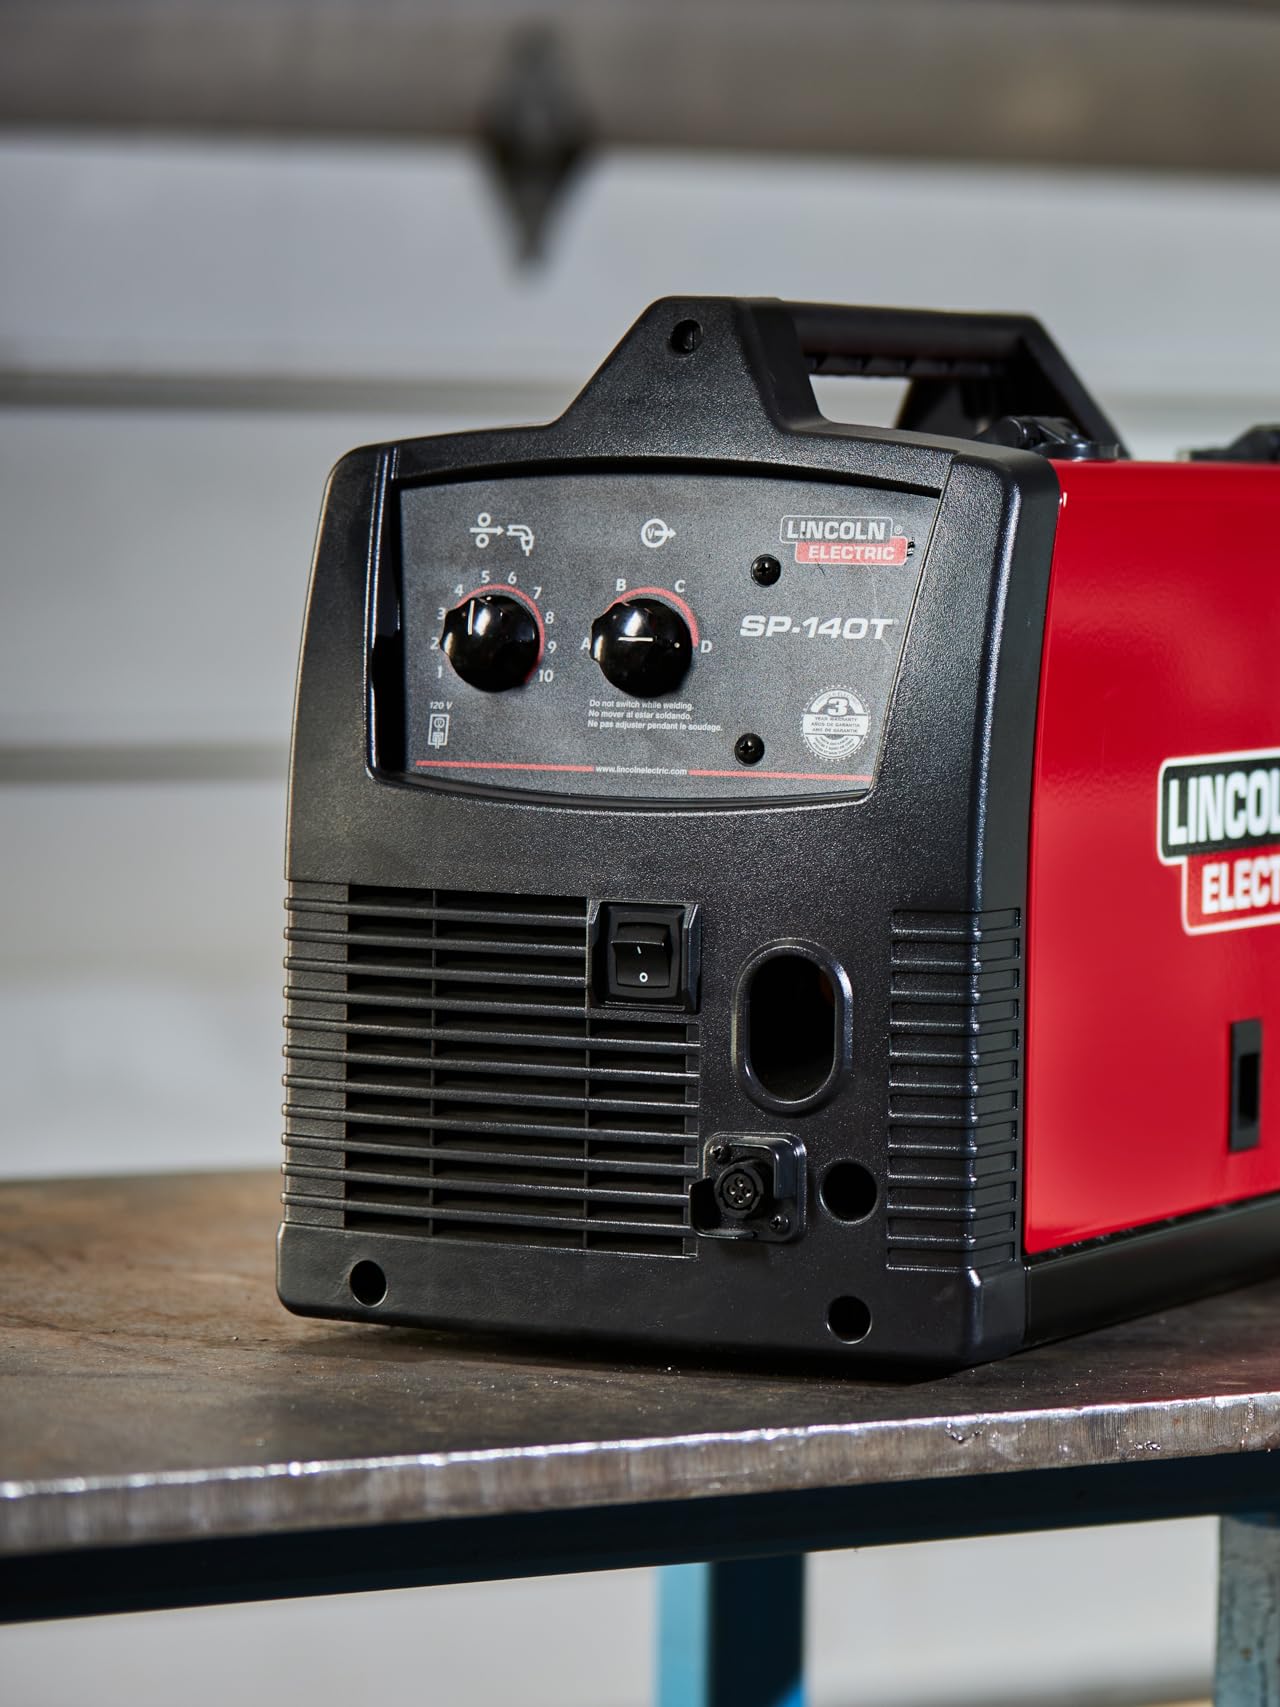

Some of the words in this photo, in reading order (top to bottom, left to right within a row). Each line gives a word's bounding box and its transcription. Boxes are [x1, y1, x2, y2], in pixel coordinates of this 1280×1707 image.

[787, 520, 885, 540] LINCOLN
[807, 545, 895, 561] ELECTRIC
[480, 570, 490, 583] 5
[507, 571, 518, 585] 6
[454, 584, 464, 597] 4
[616, 578, 627, 592] B
[674, 579, 686, 593] C
[533, 587, 542, 600] 7
[437, 608, 446, 621] 3
[545, 612, 555, 625] 8
[740, 615, 893, 640] SP-140T
[430, 637, 441, 651] 2
[547, 641, 557, 655] 9
[580, 637, 591, 650] A
[701, 640, 713, 653] D
[437, 666, 443, 679] 1
[538, 670, 554, 683] 10
[429, 702, 445, 710] 120
[446, 702, 453, 710] V
[589, 700, 600, 708] Do
[602, 700, 615, 708] not
[615, 701, 640, 709] switch
[641, 702, 662, 710] while
[663, 702, 695, 712] welding.
[827, 698, 848, 717] 3
[588, 710, 600, 718] No
[601, 711, 625, 719] mover
[626, 711, 633, 719] al
[634, 711, 654, 720] estar
[655, 712, 692, 721] soldando.
[587, 720, 599, 728] Ne
[600, 721, 614, 730] pas
[615, 721, 646, 730] adjuster
[647, 722, 678, 731] pendant
[679, 723, 687, 731] le
[688, 724, 723, 733] soudage.
[595, 765, 688, 776] www.lincolnelectric.com
